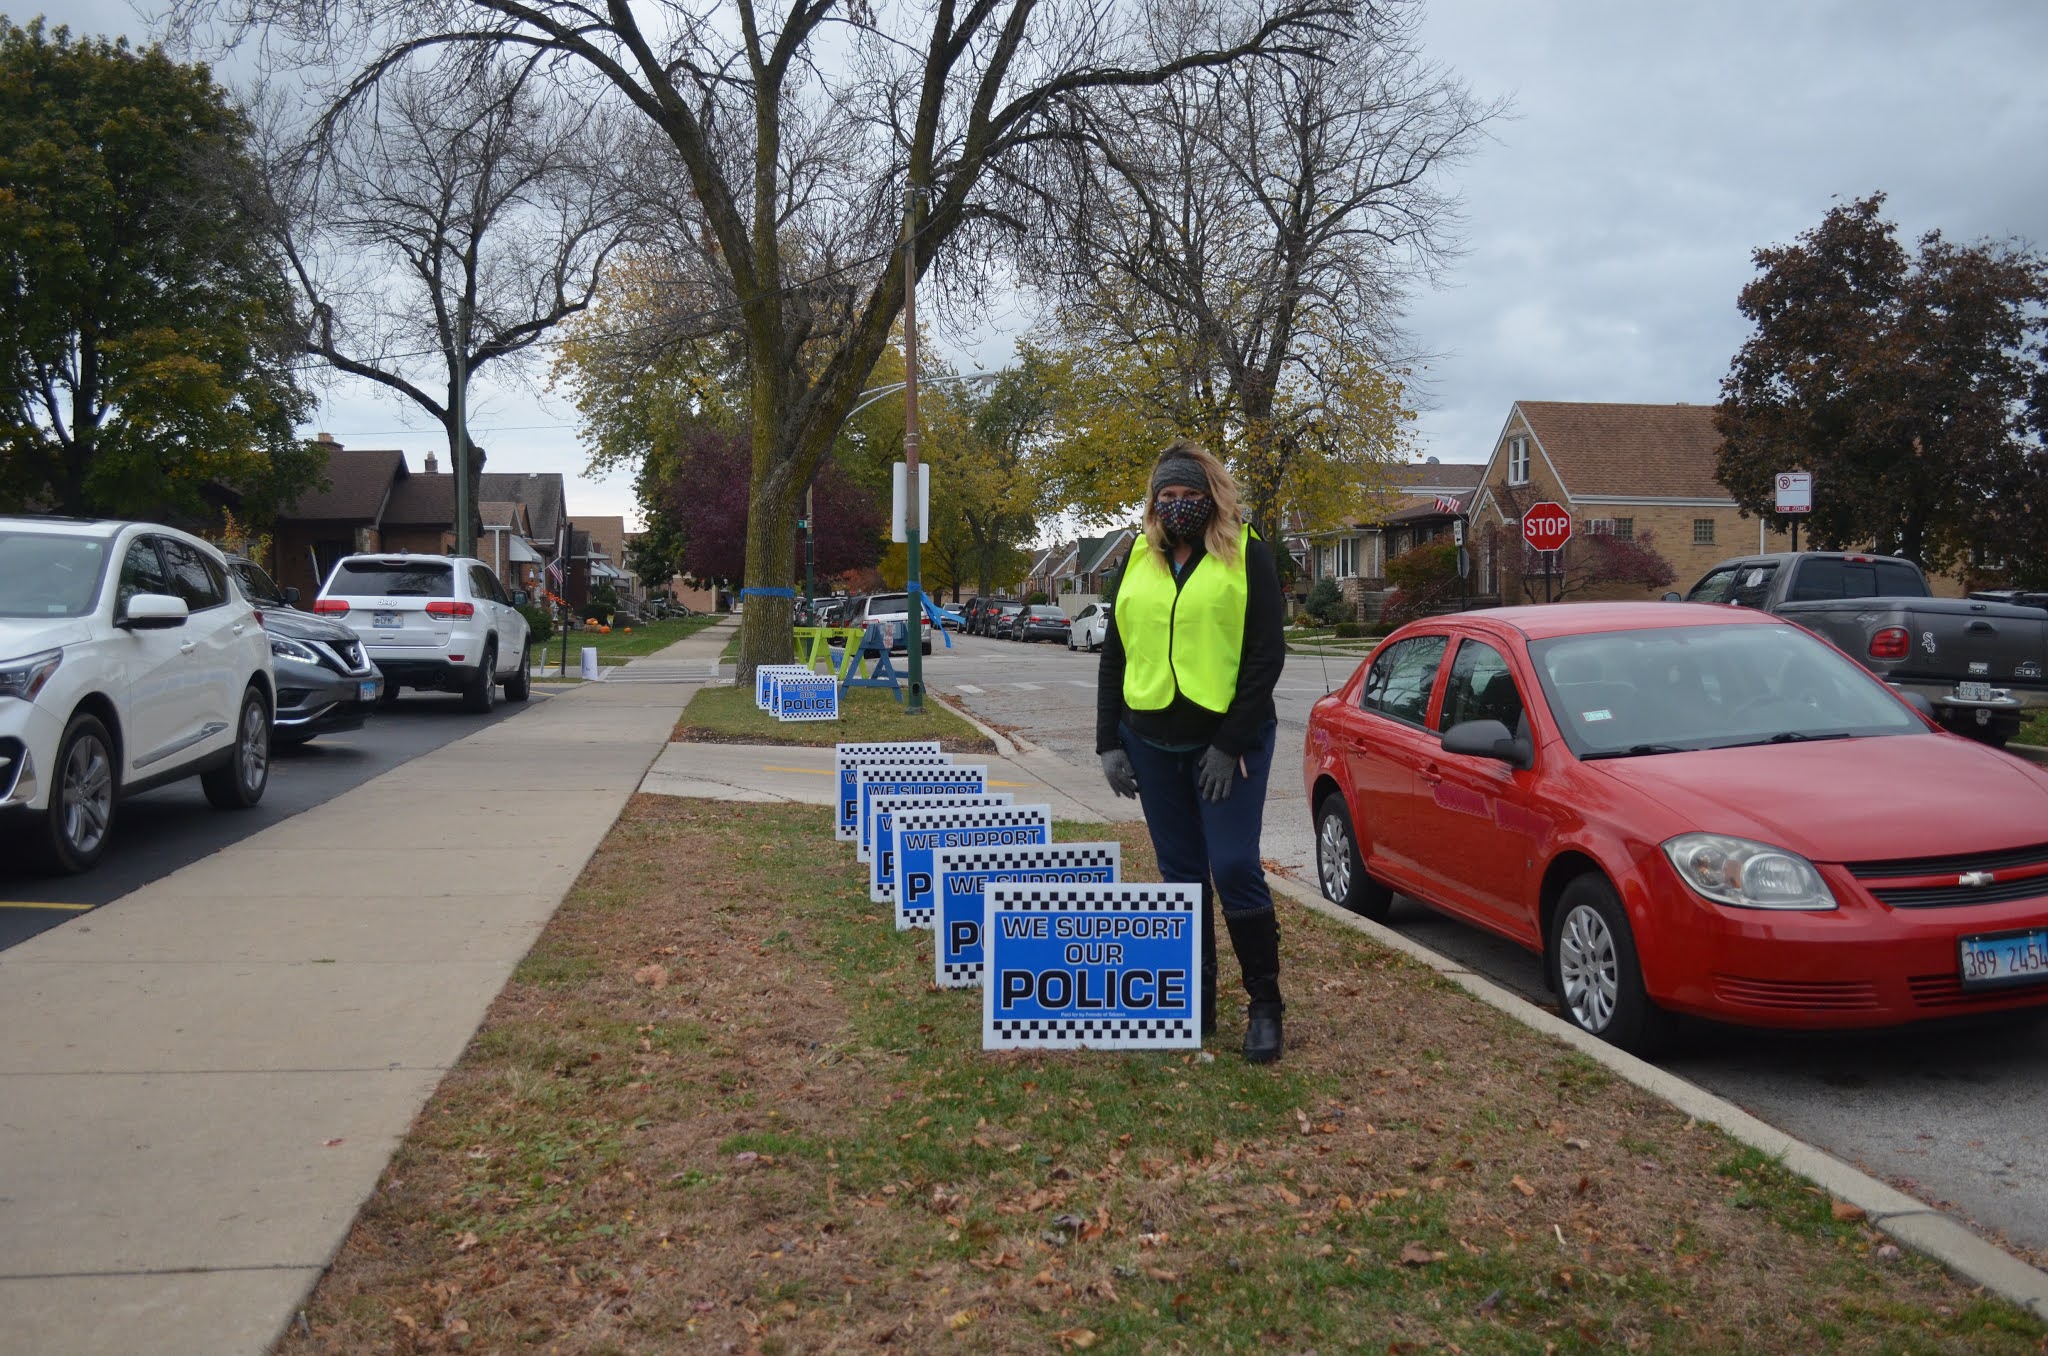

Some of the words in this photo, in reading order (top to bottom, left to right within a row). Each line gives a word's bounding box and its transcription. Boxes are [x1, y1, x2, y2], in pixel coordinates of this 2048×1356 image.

[1526, 517, 1568, 536] STOP
[377, 599, 397, 607] Jeep
[2015, 667, 2041, 677] SOX
[783, 698, 834, 710] POLICE
[868, 785, 895, 795] WE
[900, 785, 978, 795] SUPPORT
[906, 834, 939, 850] WE
[945, 829, 1040, 848] SUPPORT
[949, 875, 985, 894] WE
[1002, 917, 1048, 939] WE
[1055, 917, 1186, 939] SUPPORT
[1064, 943, 1123, 965] OUR
[1965, 949, 1996, 976] 389
[2008, 944, 2048, 972] 2454
[1001, 969, 1186, 1010] POLICE
